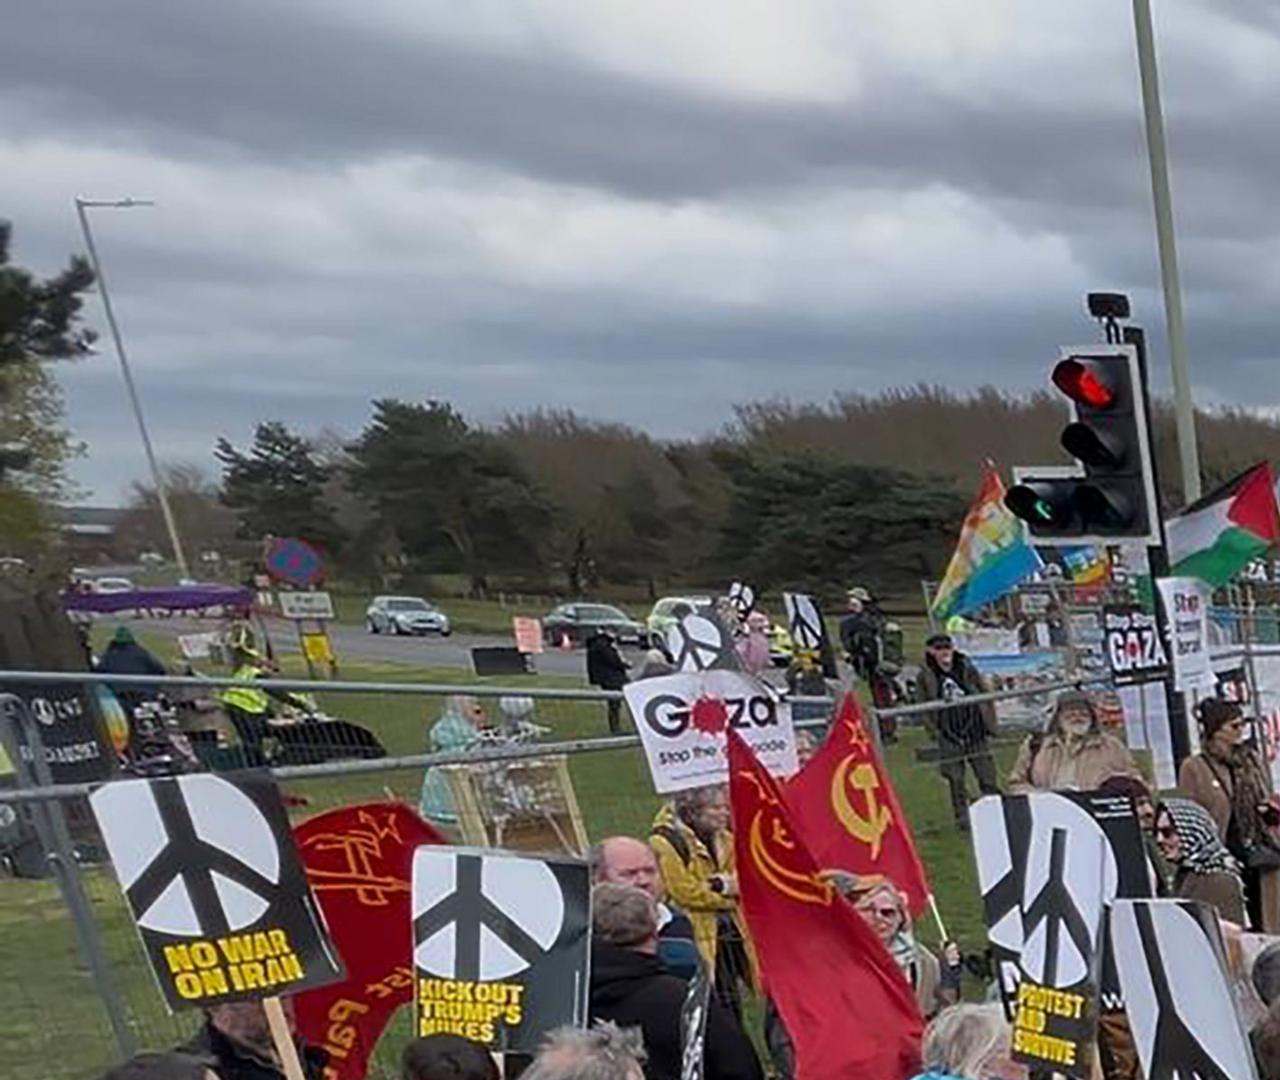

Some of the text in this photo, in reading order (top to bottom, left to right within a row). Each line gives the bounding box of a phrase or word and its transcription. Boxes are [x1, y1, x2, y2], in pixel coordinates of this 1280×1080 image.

[163, 941, 218, 973] NO
[217, 930, 290, 963] WAR
[175, 954, 304, 999] ON IRAN
[420, 979, 475, 1001] KICK
[474, 983, 524, 1005] OUT
[420, 999, 522, 1024] TRUMP'S
[1019, 982, 1084, 1019] PROTEST
[420, 1018, 495, 1042] NUKES
[1016, 1006, 1046, 1033] AND
[1014, 1030, 1077, 1066] SURVIVE
